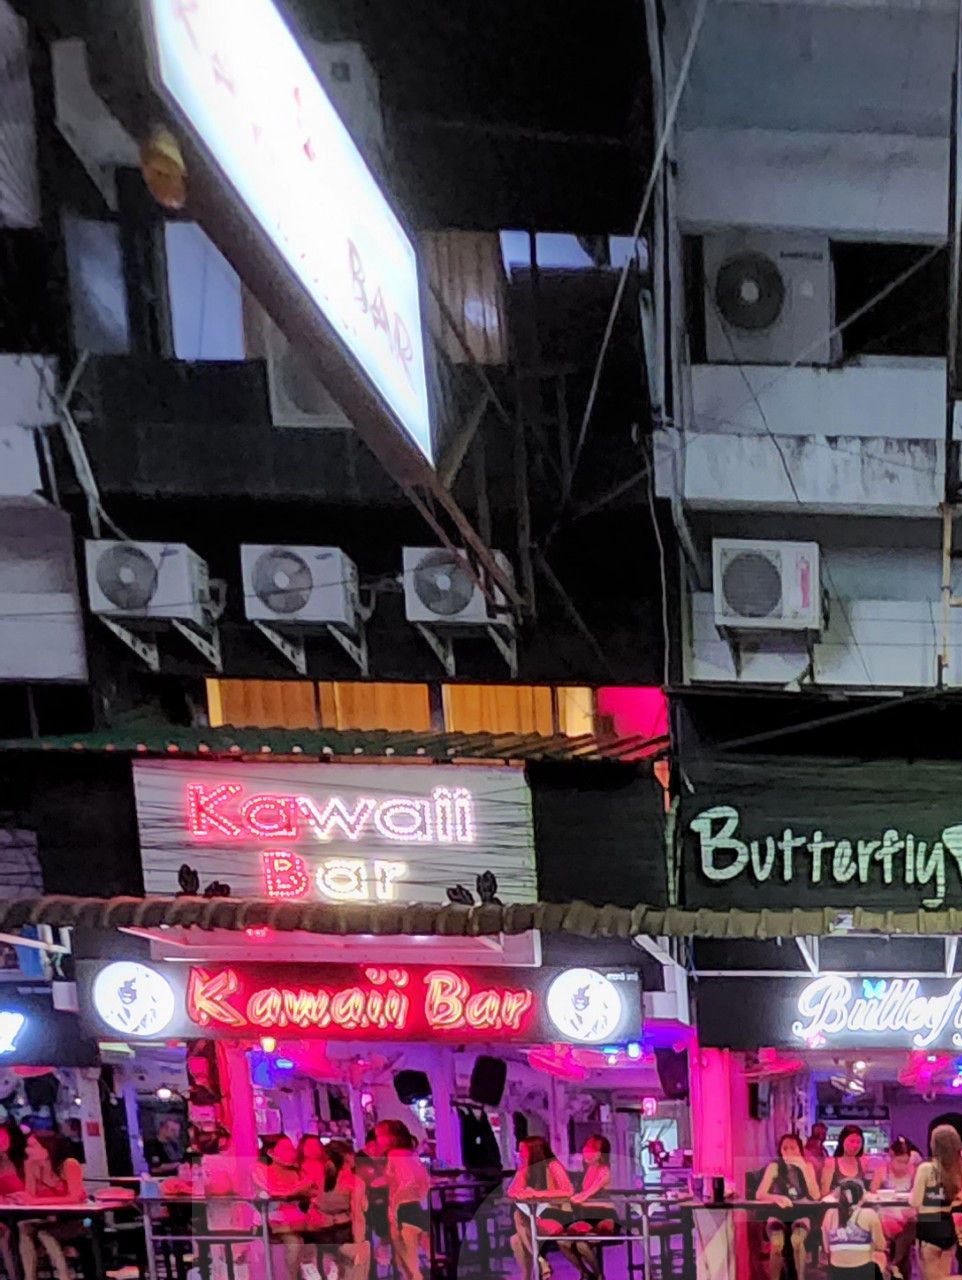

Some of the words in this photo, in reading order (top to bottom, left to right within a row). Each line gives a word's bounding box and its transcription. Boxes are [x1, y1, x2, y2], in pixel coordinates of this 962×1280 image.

[186, 783, 474, 843] Kawaii
[262, 850, 408, 898] Bar
[690, 805, 948, 908] Butterfly
[187, 966, 410, 1029] Kawaii
[423, 968, 532, 1030] Bar
